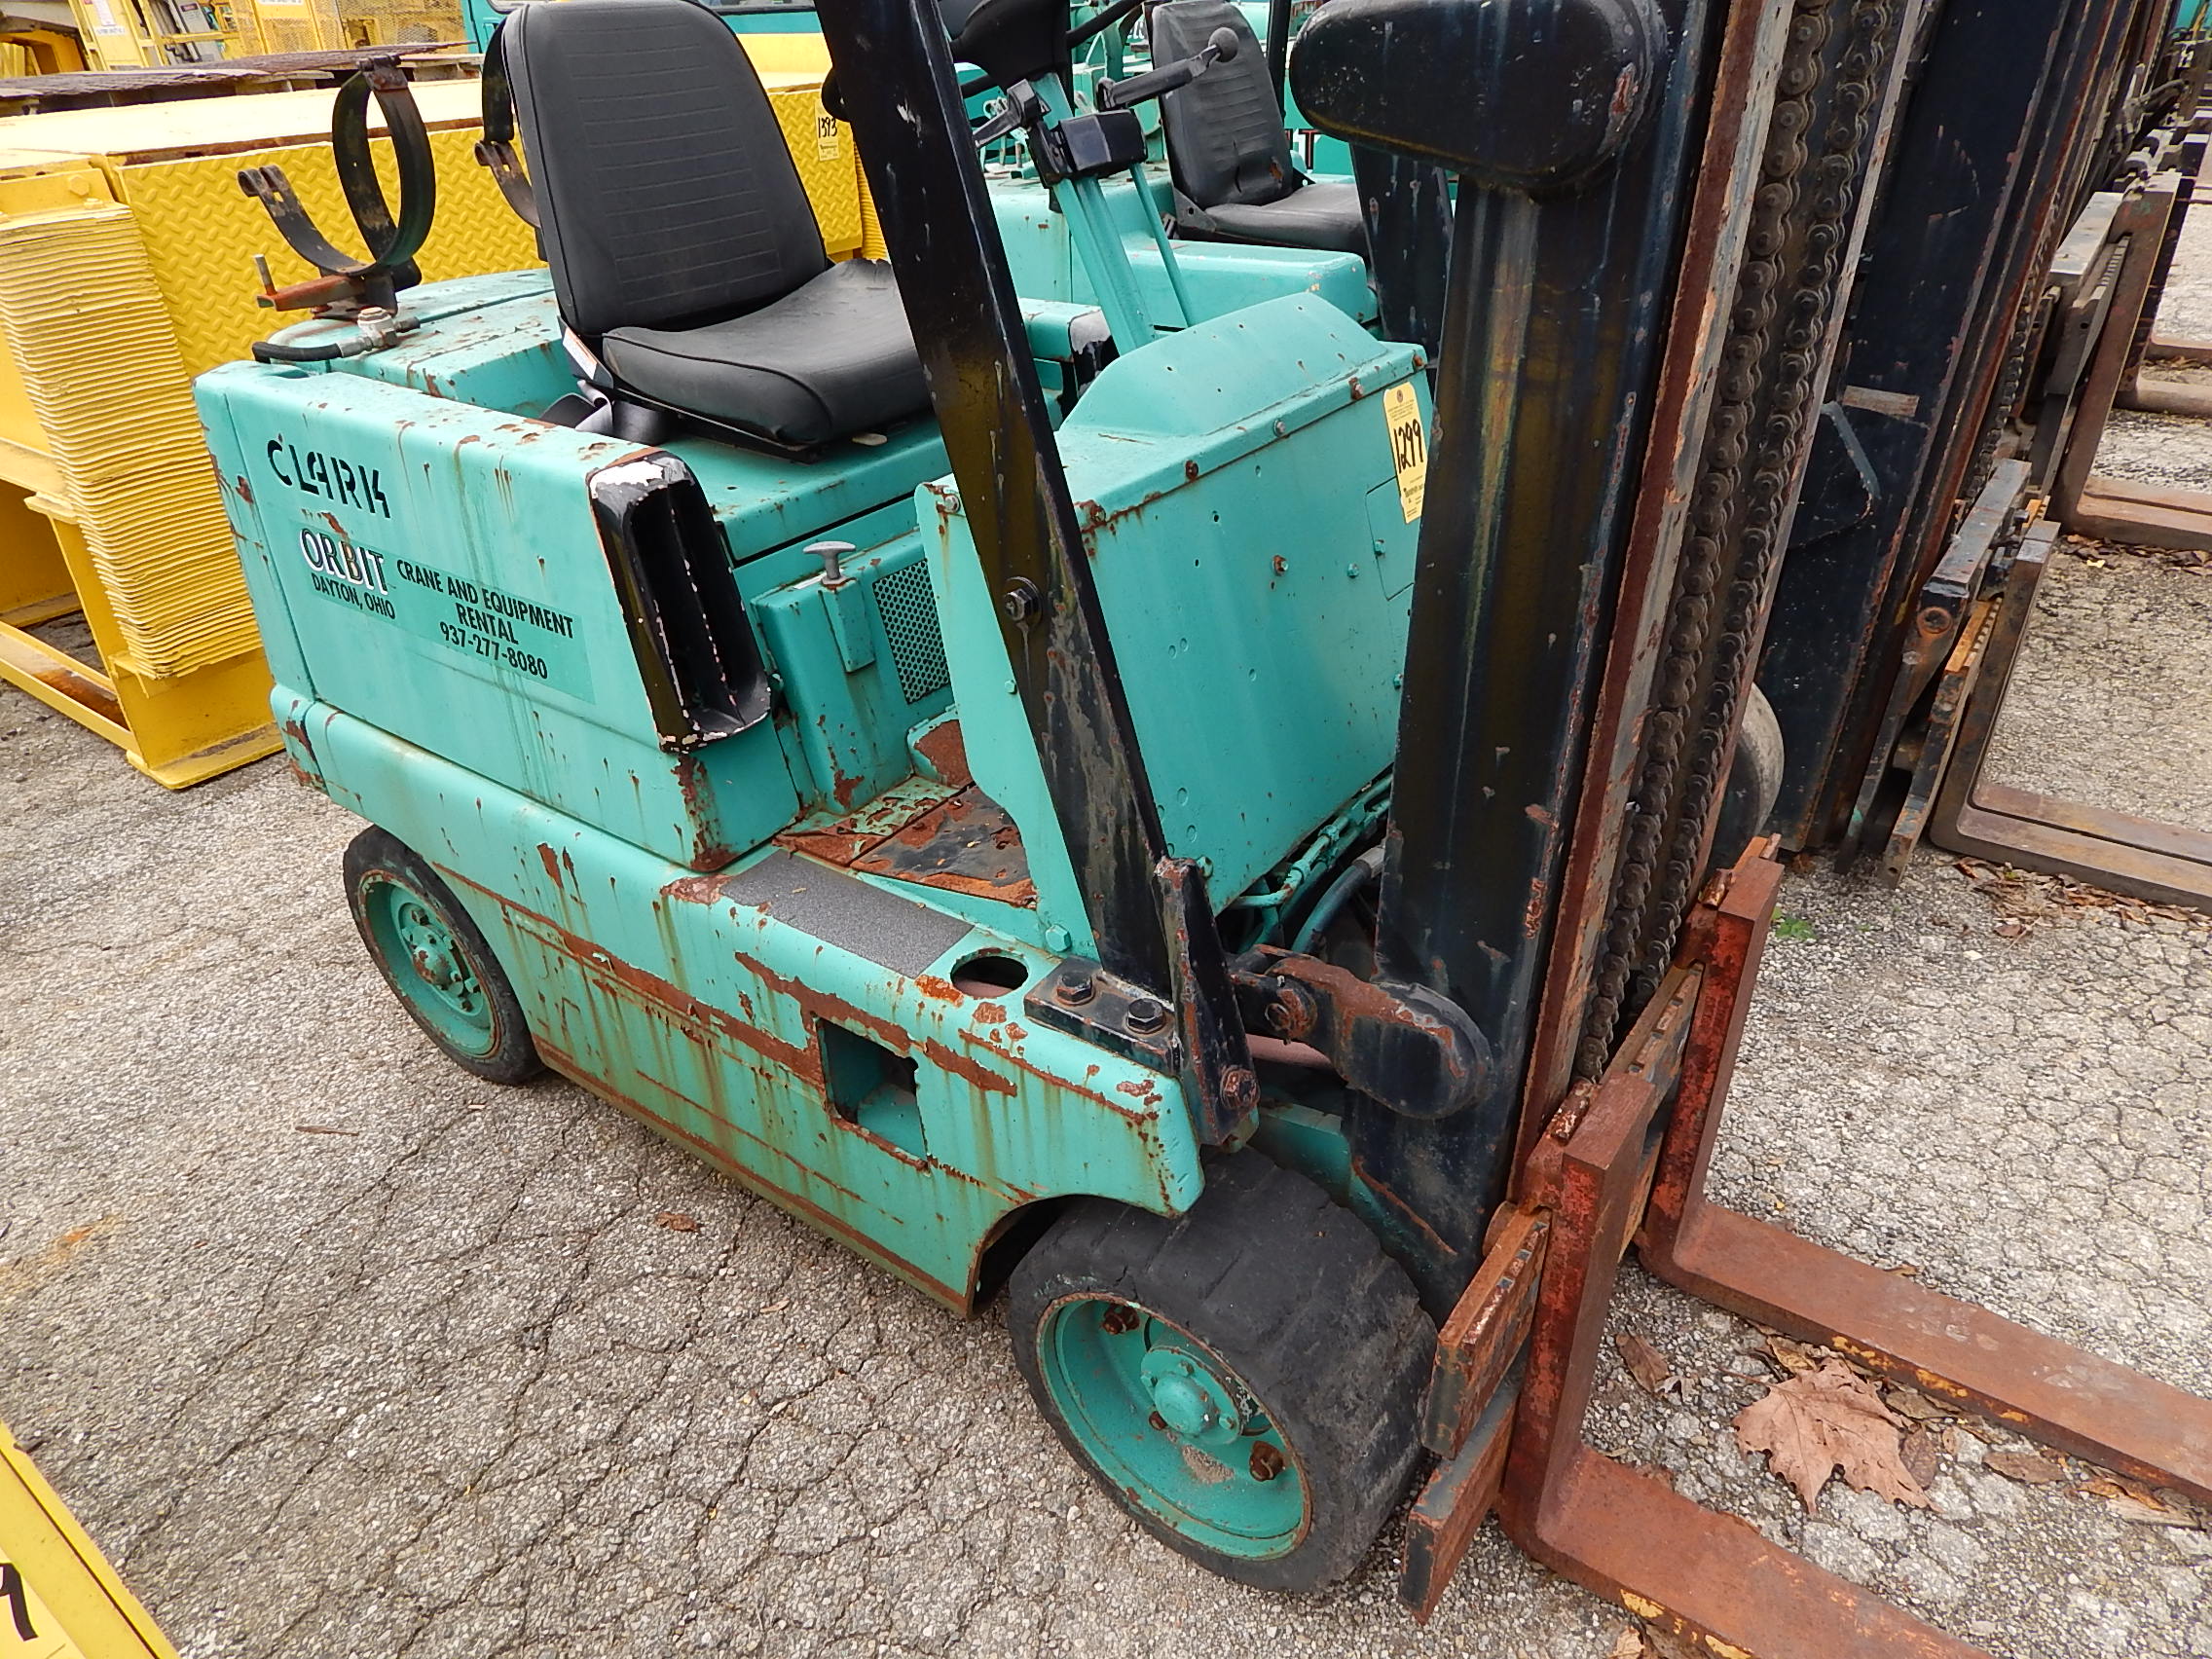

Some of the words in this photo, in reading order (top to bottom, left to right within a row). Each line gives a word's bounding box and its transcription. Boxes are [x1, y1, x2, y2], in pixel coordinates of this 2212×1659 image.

[818, 116, 837, 138] 1393
[1393, 418, 1424, 475] 1299
[268, 439, 390, 519] CLARK
[300, 528, 388, 595] ORBIT
[311, 572, 363, 610] DAYTON,
[363, 592, 395, 619] OHIO
[396, 559, 444, 593] CRANE
[447, 576, 479, 605] AND
[481, 588, 573, 639] EQUIPMENT
[456, 602, 519, 645] RENTAL
[439, 621, 548, 680] 937-277-8080
